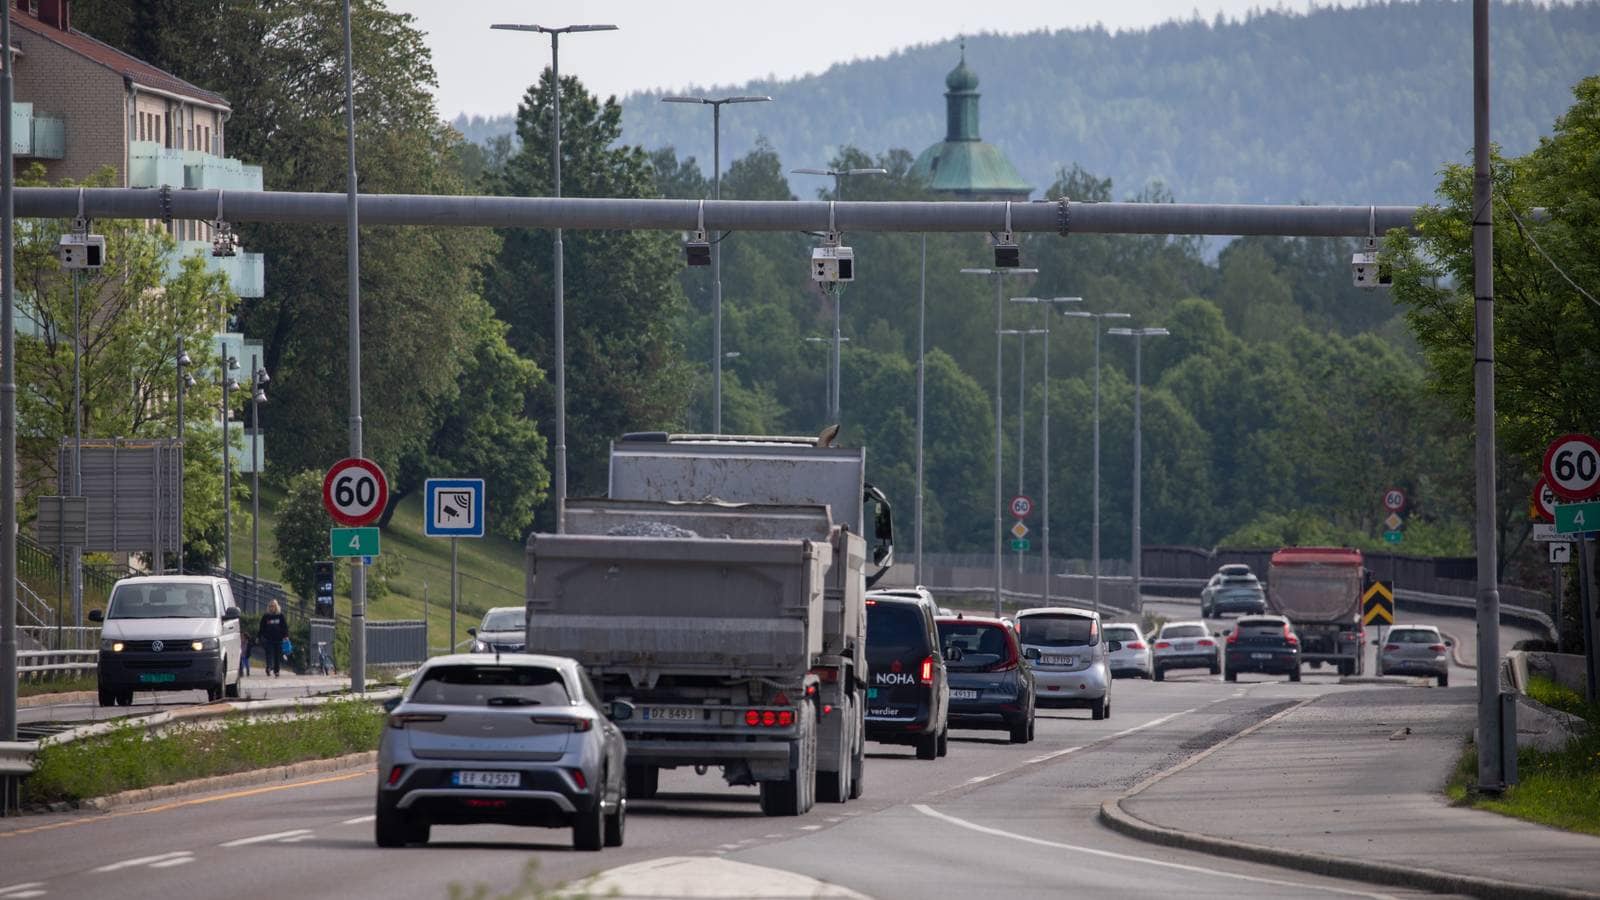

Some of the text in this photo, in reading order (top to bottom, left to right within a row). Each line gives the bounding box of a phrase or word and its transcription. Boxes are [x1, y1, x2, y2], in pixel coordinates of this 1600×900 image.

[1555, 449, 1597, 482] 60
[336, 475, 375, 508] 60
[1014, 500, 1028, 512] 60
[1387, 494, 1401, 505] 60
[1573, 510, 1585, 526] 4
[348, 534, 361, 551] 4
[876, 673, 915, 684] NOHA
[870, 707, 899, 715] verdier
